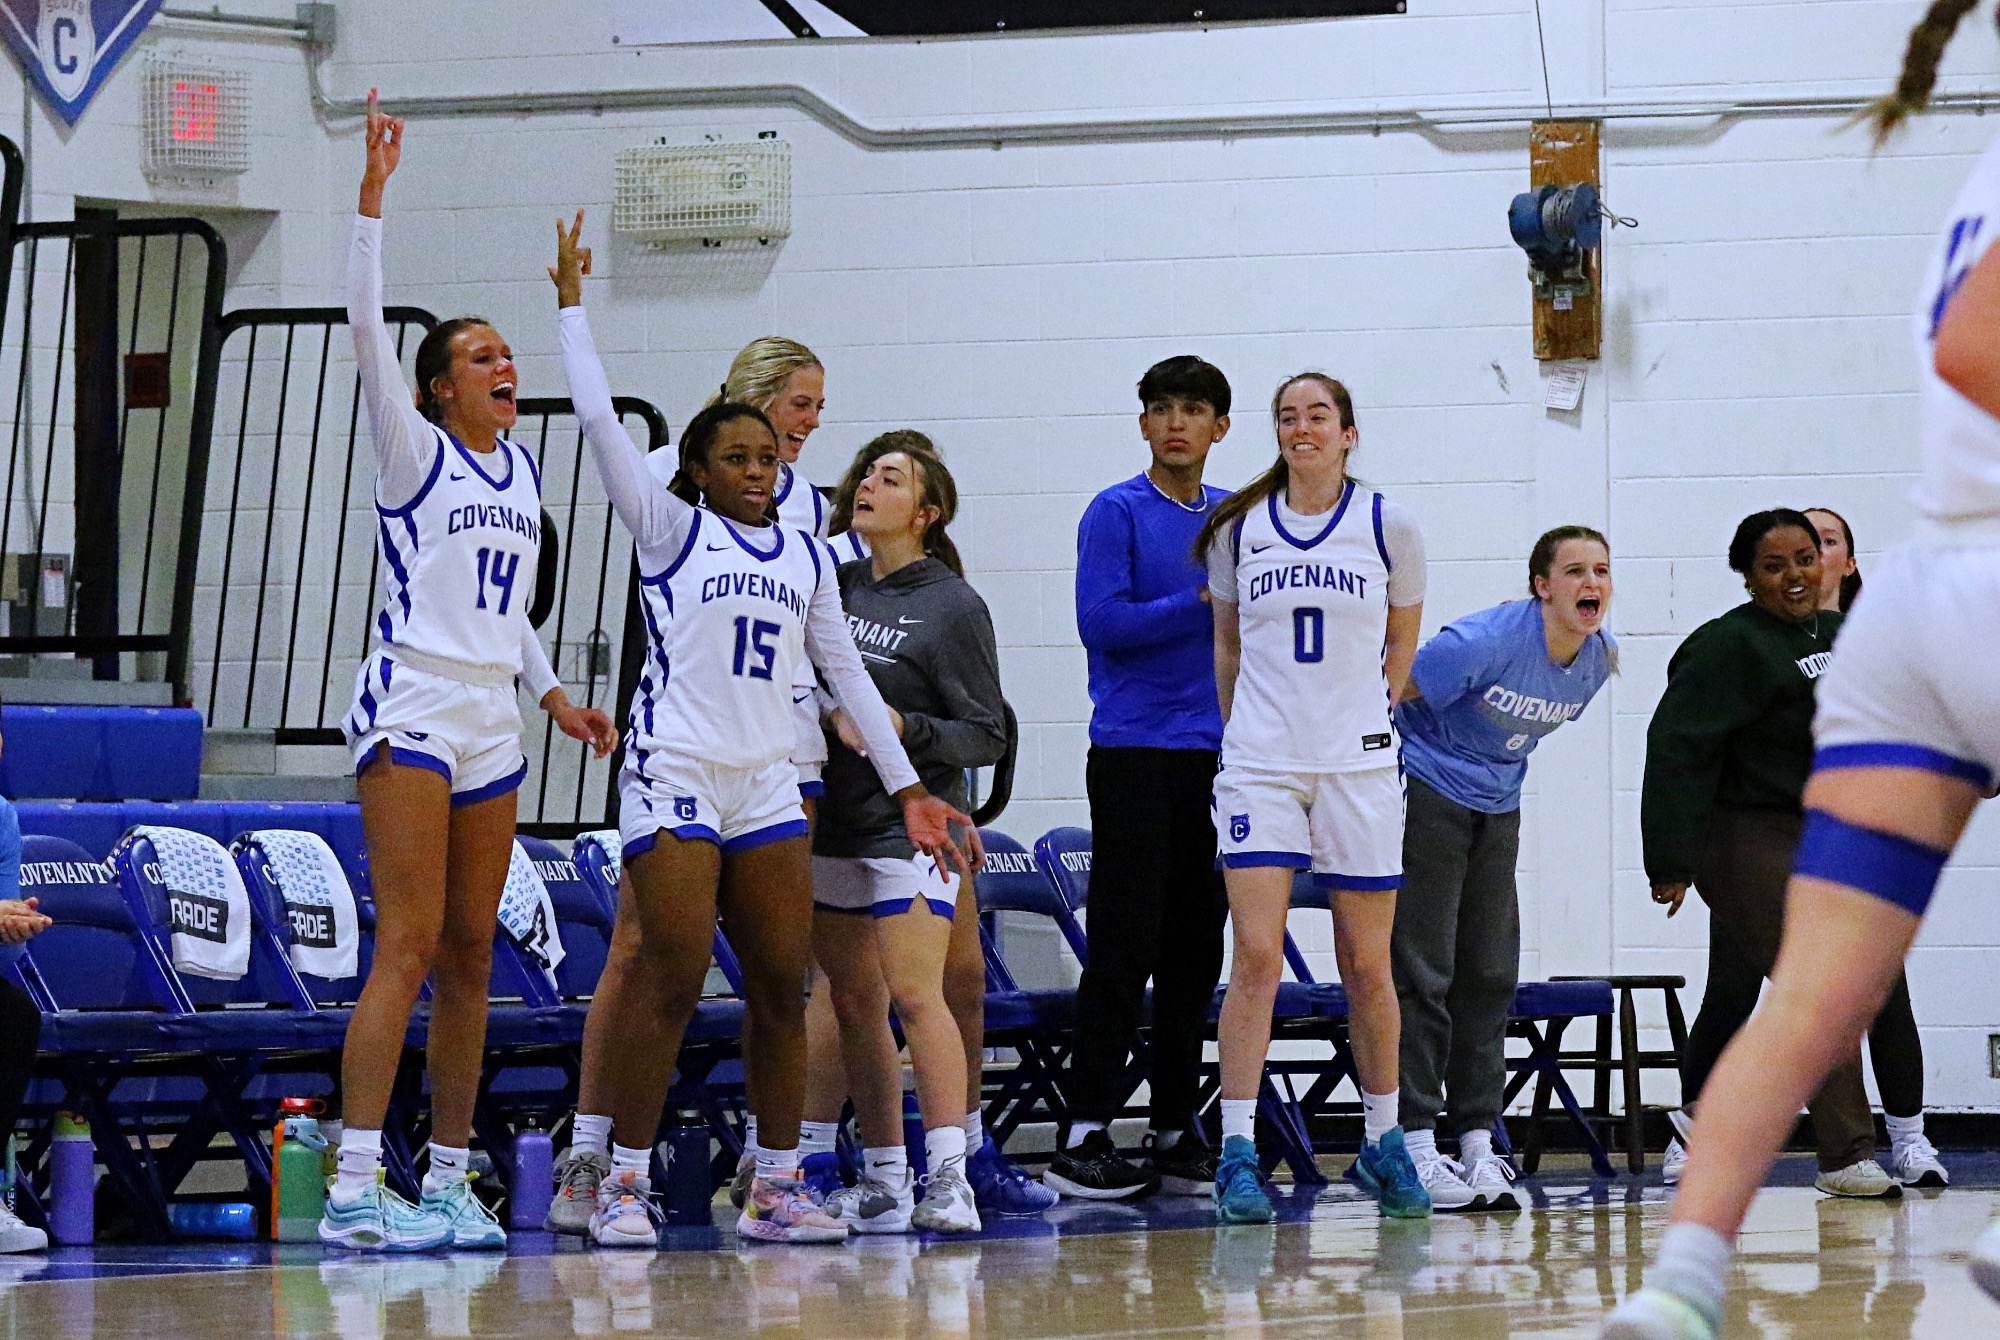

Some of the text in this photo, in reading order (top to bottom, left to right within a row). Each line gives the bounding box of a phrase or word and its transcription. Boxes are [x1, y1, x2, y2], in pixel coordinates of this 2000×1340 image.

[53, 17, 78, 74] C
[476, 547, 520, 615] 14
[1250, 564, 1367, 602] COVENANT
[732, 616, 781, 681] 15
[1293, 607, 1324, 662] 0
[1482, 684, 1584, 723] COVENANT
[681, 804, 693, 818] C
[1234, 824, 1245, 838] C
[1059, 851, 1093, 872] COVE
